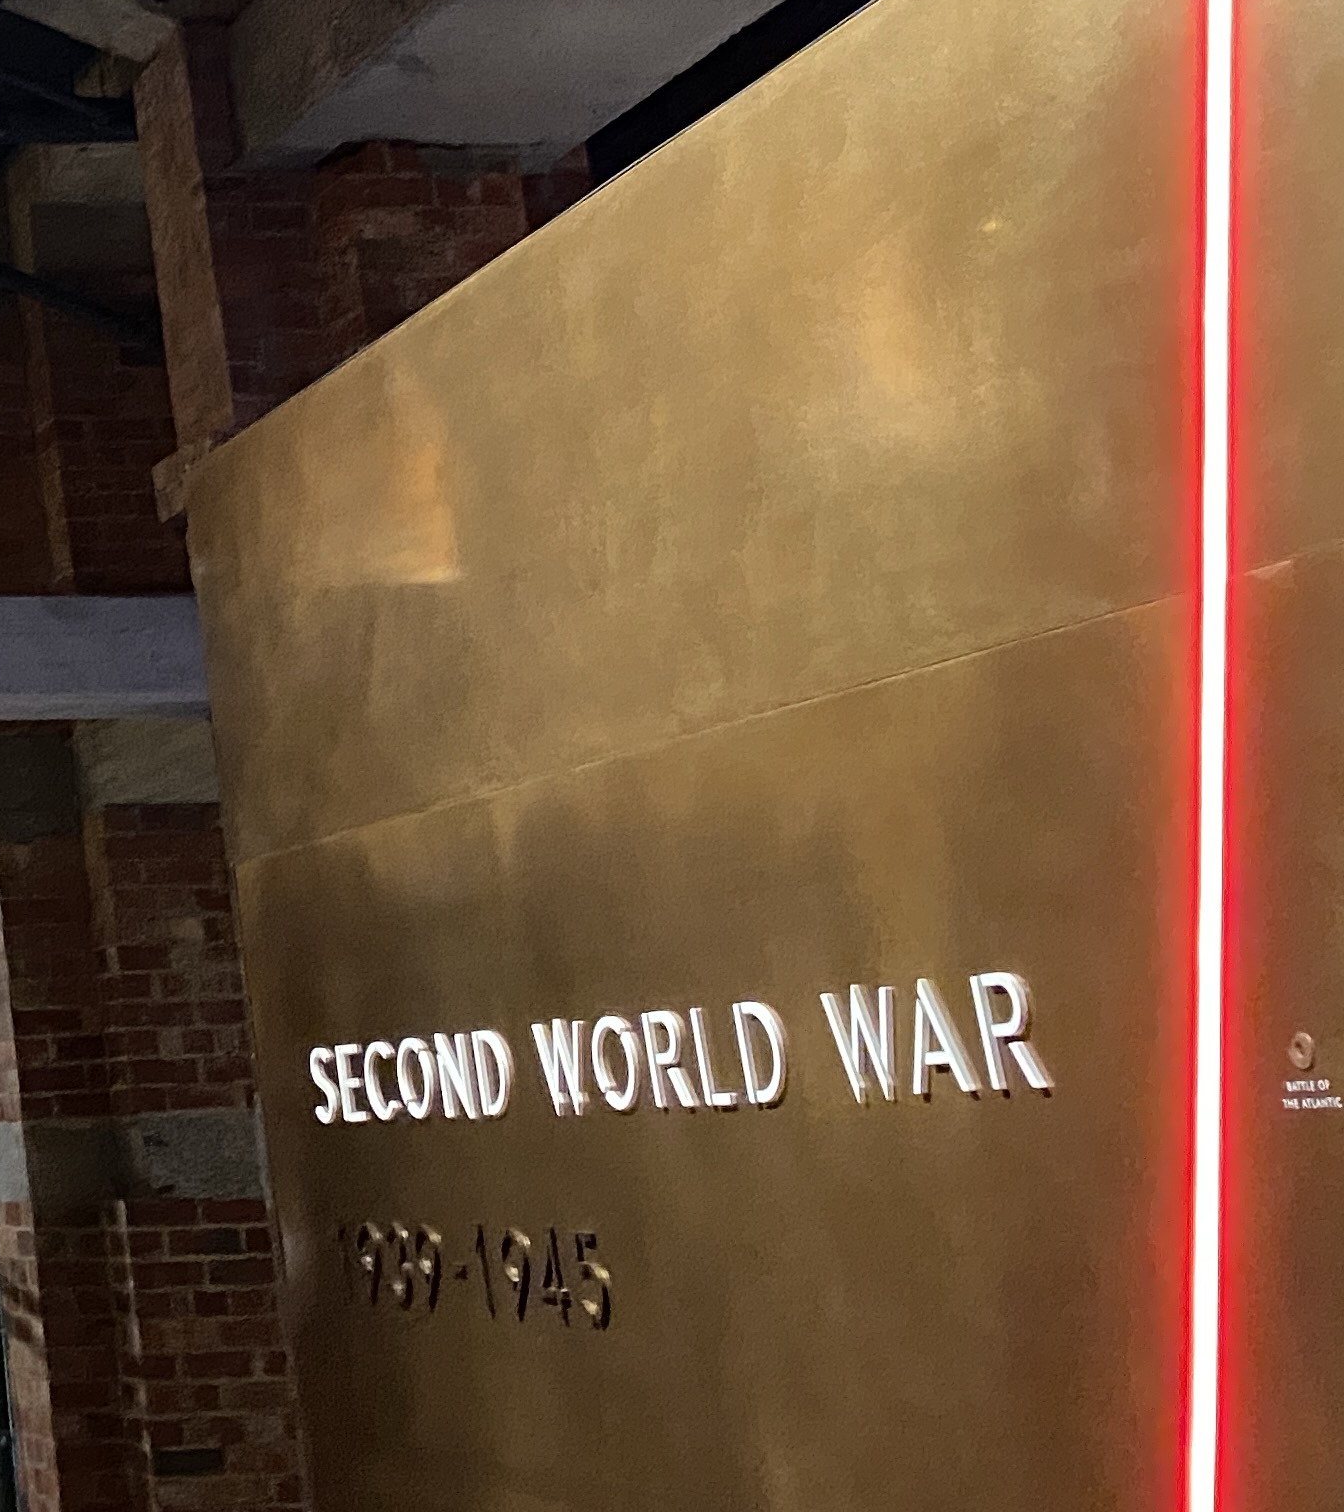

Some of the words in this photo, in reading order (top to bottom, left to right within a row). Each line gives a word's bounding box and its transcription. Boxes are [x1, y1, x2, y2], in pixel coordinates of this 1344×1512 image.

[309, 1029, 514, 1125] SECOND
[530, 1001, 787, 1117] WORLD
[819, 971, 1055, 1104] WAR
[1282, 1098, 1300, 1109] THE
[1302, 1096, 1343, 1109] ATLANTIC
[1285, 1080, 1315, 1092] BATTLE
[1317, 1078, 1330, 1091] OF
[336, 1221, 613, 1331] 1939-1945
